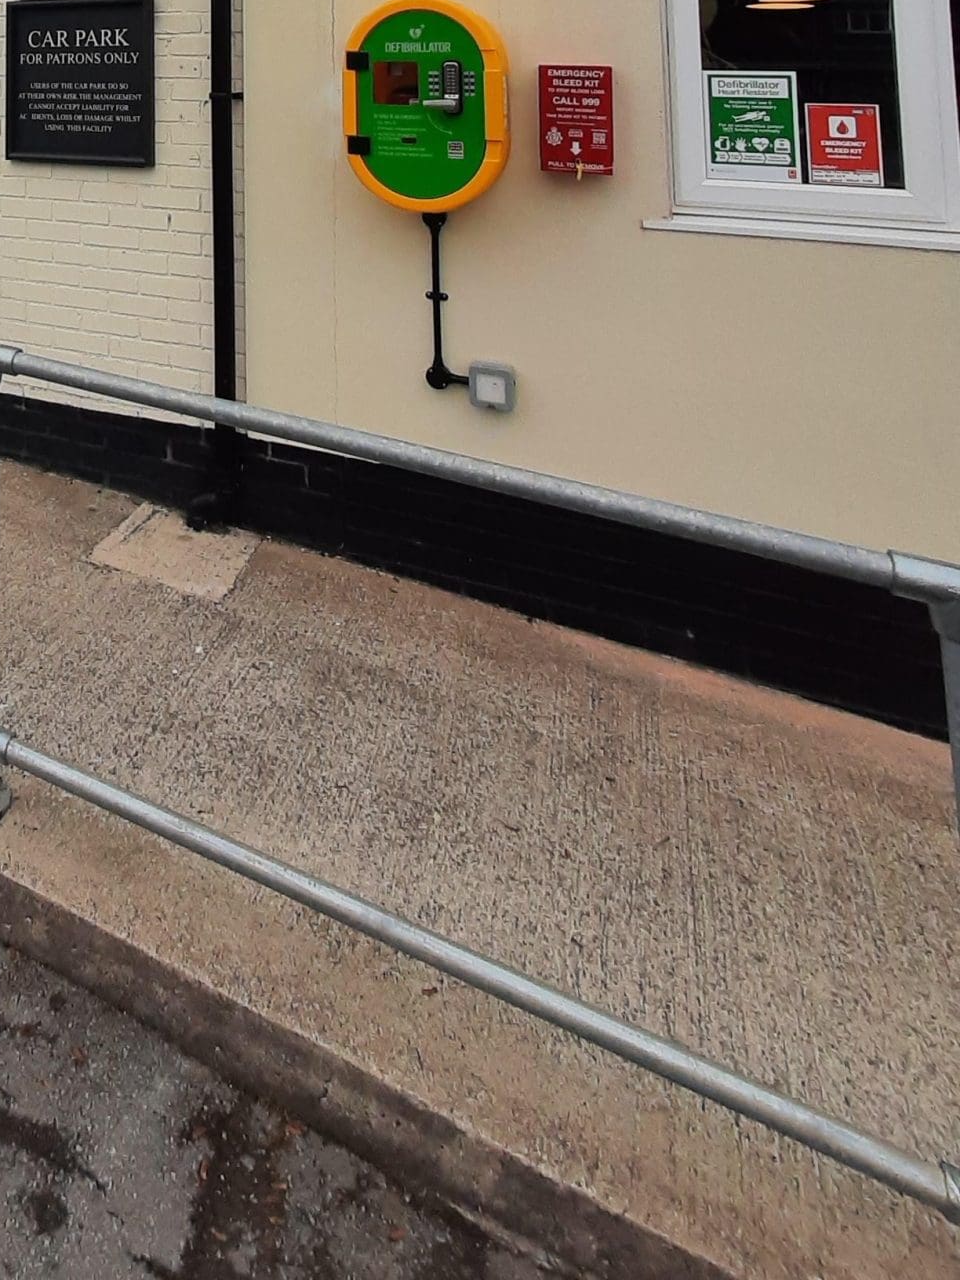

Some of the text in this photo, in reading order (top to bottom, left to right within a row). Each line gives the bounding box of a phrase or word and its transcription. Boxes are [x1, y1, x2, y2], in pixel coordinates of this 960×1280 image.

[28, 28, 130, 48] CAR PARK
[384, 41, 452, 53] DEFIBRILLATOR
[20, 51, 140, 65] FOR PATRONS ONLY
[547, 68, 605, 78] EMERGENCY
[30, 82, 50, 90] USERS
[51, 82, 59, 90] OF
[61, 82, 74, 90] THE
[74, 82, 88, 90] CAR
[89, 82, 107, 90] PARK
[552, 78, 600, 88] BLEED KIT
[717, 79, 780, 90] Defibrillator
[27, 92, 45, 100] THEIR
[93, 93, 142, 101] MANAGEMENT
[742, 88, 780, 96] Restarter
[552, 96, 601, 107] CALL 999
[84, 114, 114, 122] DAMAGE
[115, 114, 142, 123] WHILST
[44, 123, 113, 133] USING THIS FACILITY
[547, 160, 564, 168] PULL
